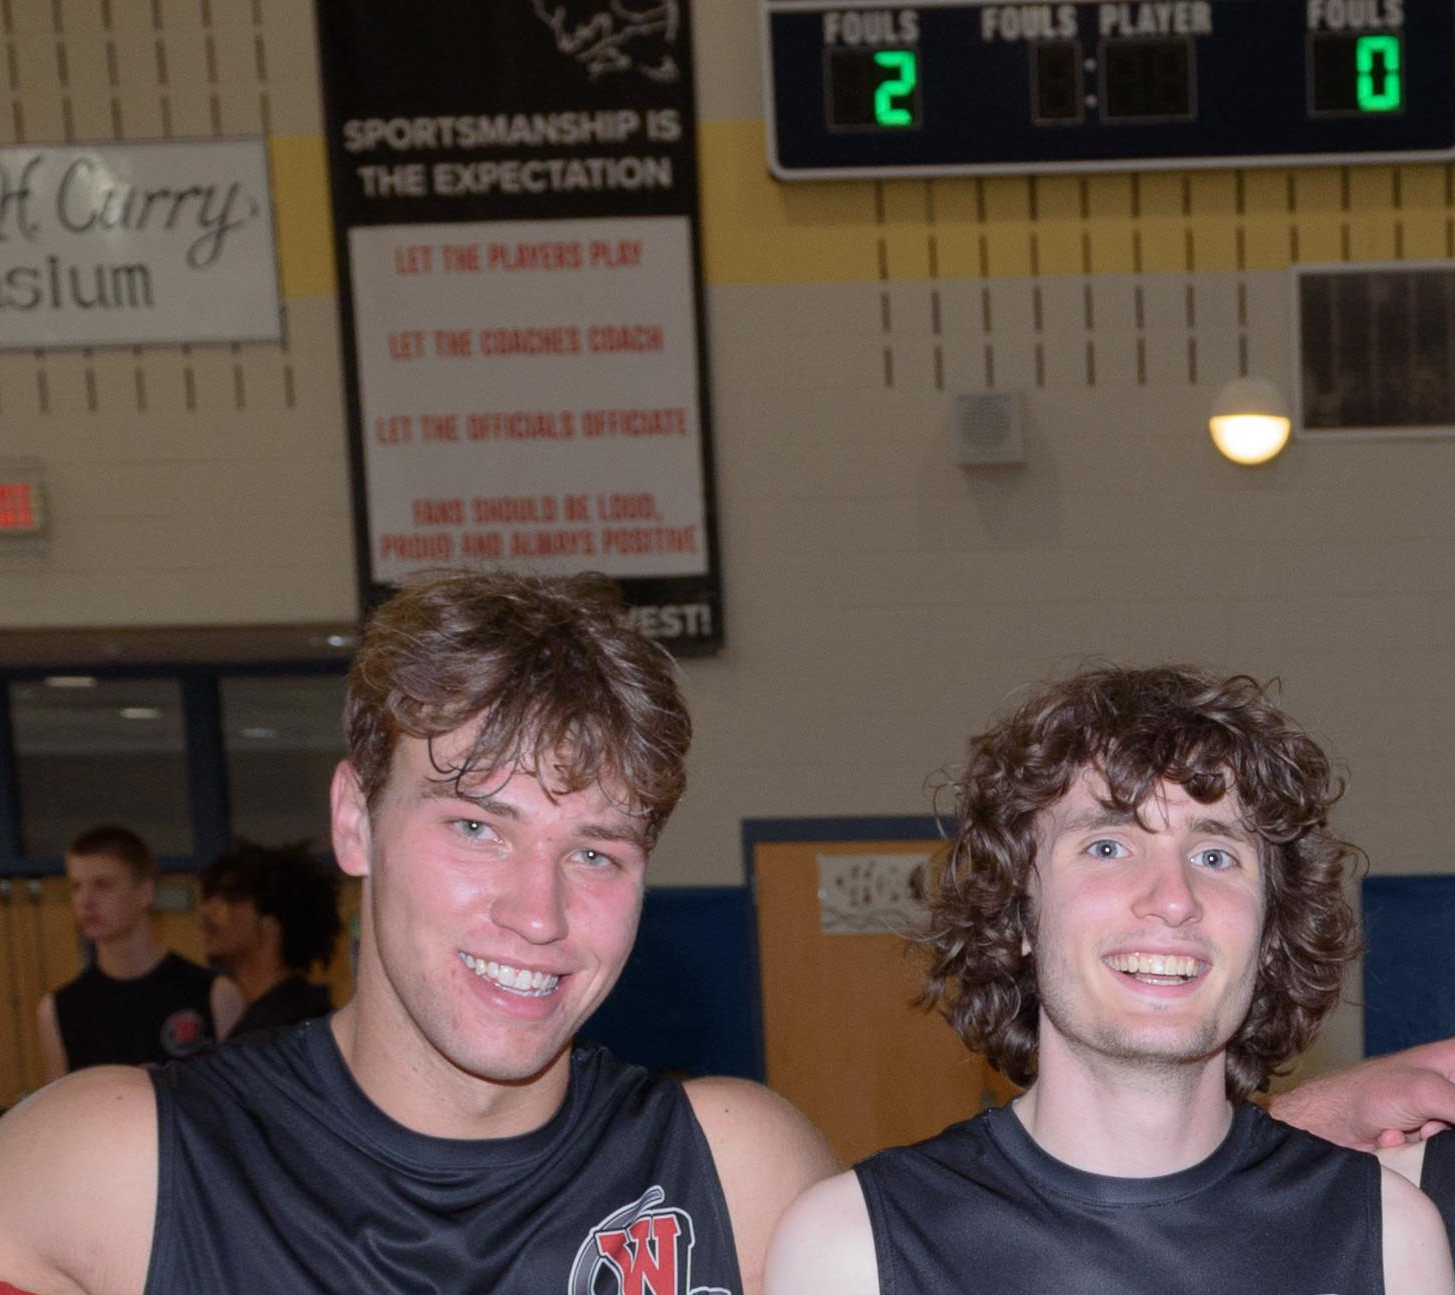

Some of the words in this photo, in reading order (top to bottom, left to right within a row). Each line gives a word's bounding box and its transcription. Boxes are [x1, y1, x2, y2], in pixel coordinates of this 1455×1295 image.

[824, 11, 920, 43] FOULS
[981, 4, 1079, 40] FOULS
[1099, 1, 1213, 36] PLAYER
[1306, 0, 1406, 28] FOULS
[873, 50, 917, 127] 2
[1355, 34, 1401, 111] 0
[343, 110, 641, 152] SPORTSMANSHIP
[646, 109, 682, 142] IS
[357, 163, 427, 197] THE
[432, 156, 672, 195] EXPECTATION
[396, 245, 431, 275] LET
[443, 244, 480, 272] THE
[488, 242, 581, 272] PLAYERS
[589, 239, 642, 268] PLAY
[389, 330, 424, 360] LET
[434, 329, 472, 358] THE
[480, 326, 580, 356] COACHES
[588, 324, 664, 353] COACH
[376, 415, 412, 445] LET
[421, 414, 458, 443] THE
[466, 411, 575, 441] OFFICIALS
[582, 408, 688, 438] OFFICIATE
[564, 495, 588, 521] BE
[511, 530, 593, 556] ALWAYS
[602, 525, 698, 554] POSITIVE
